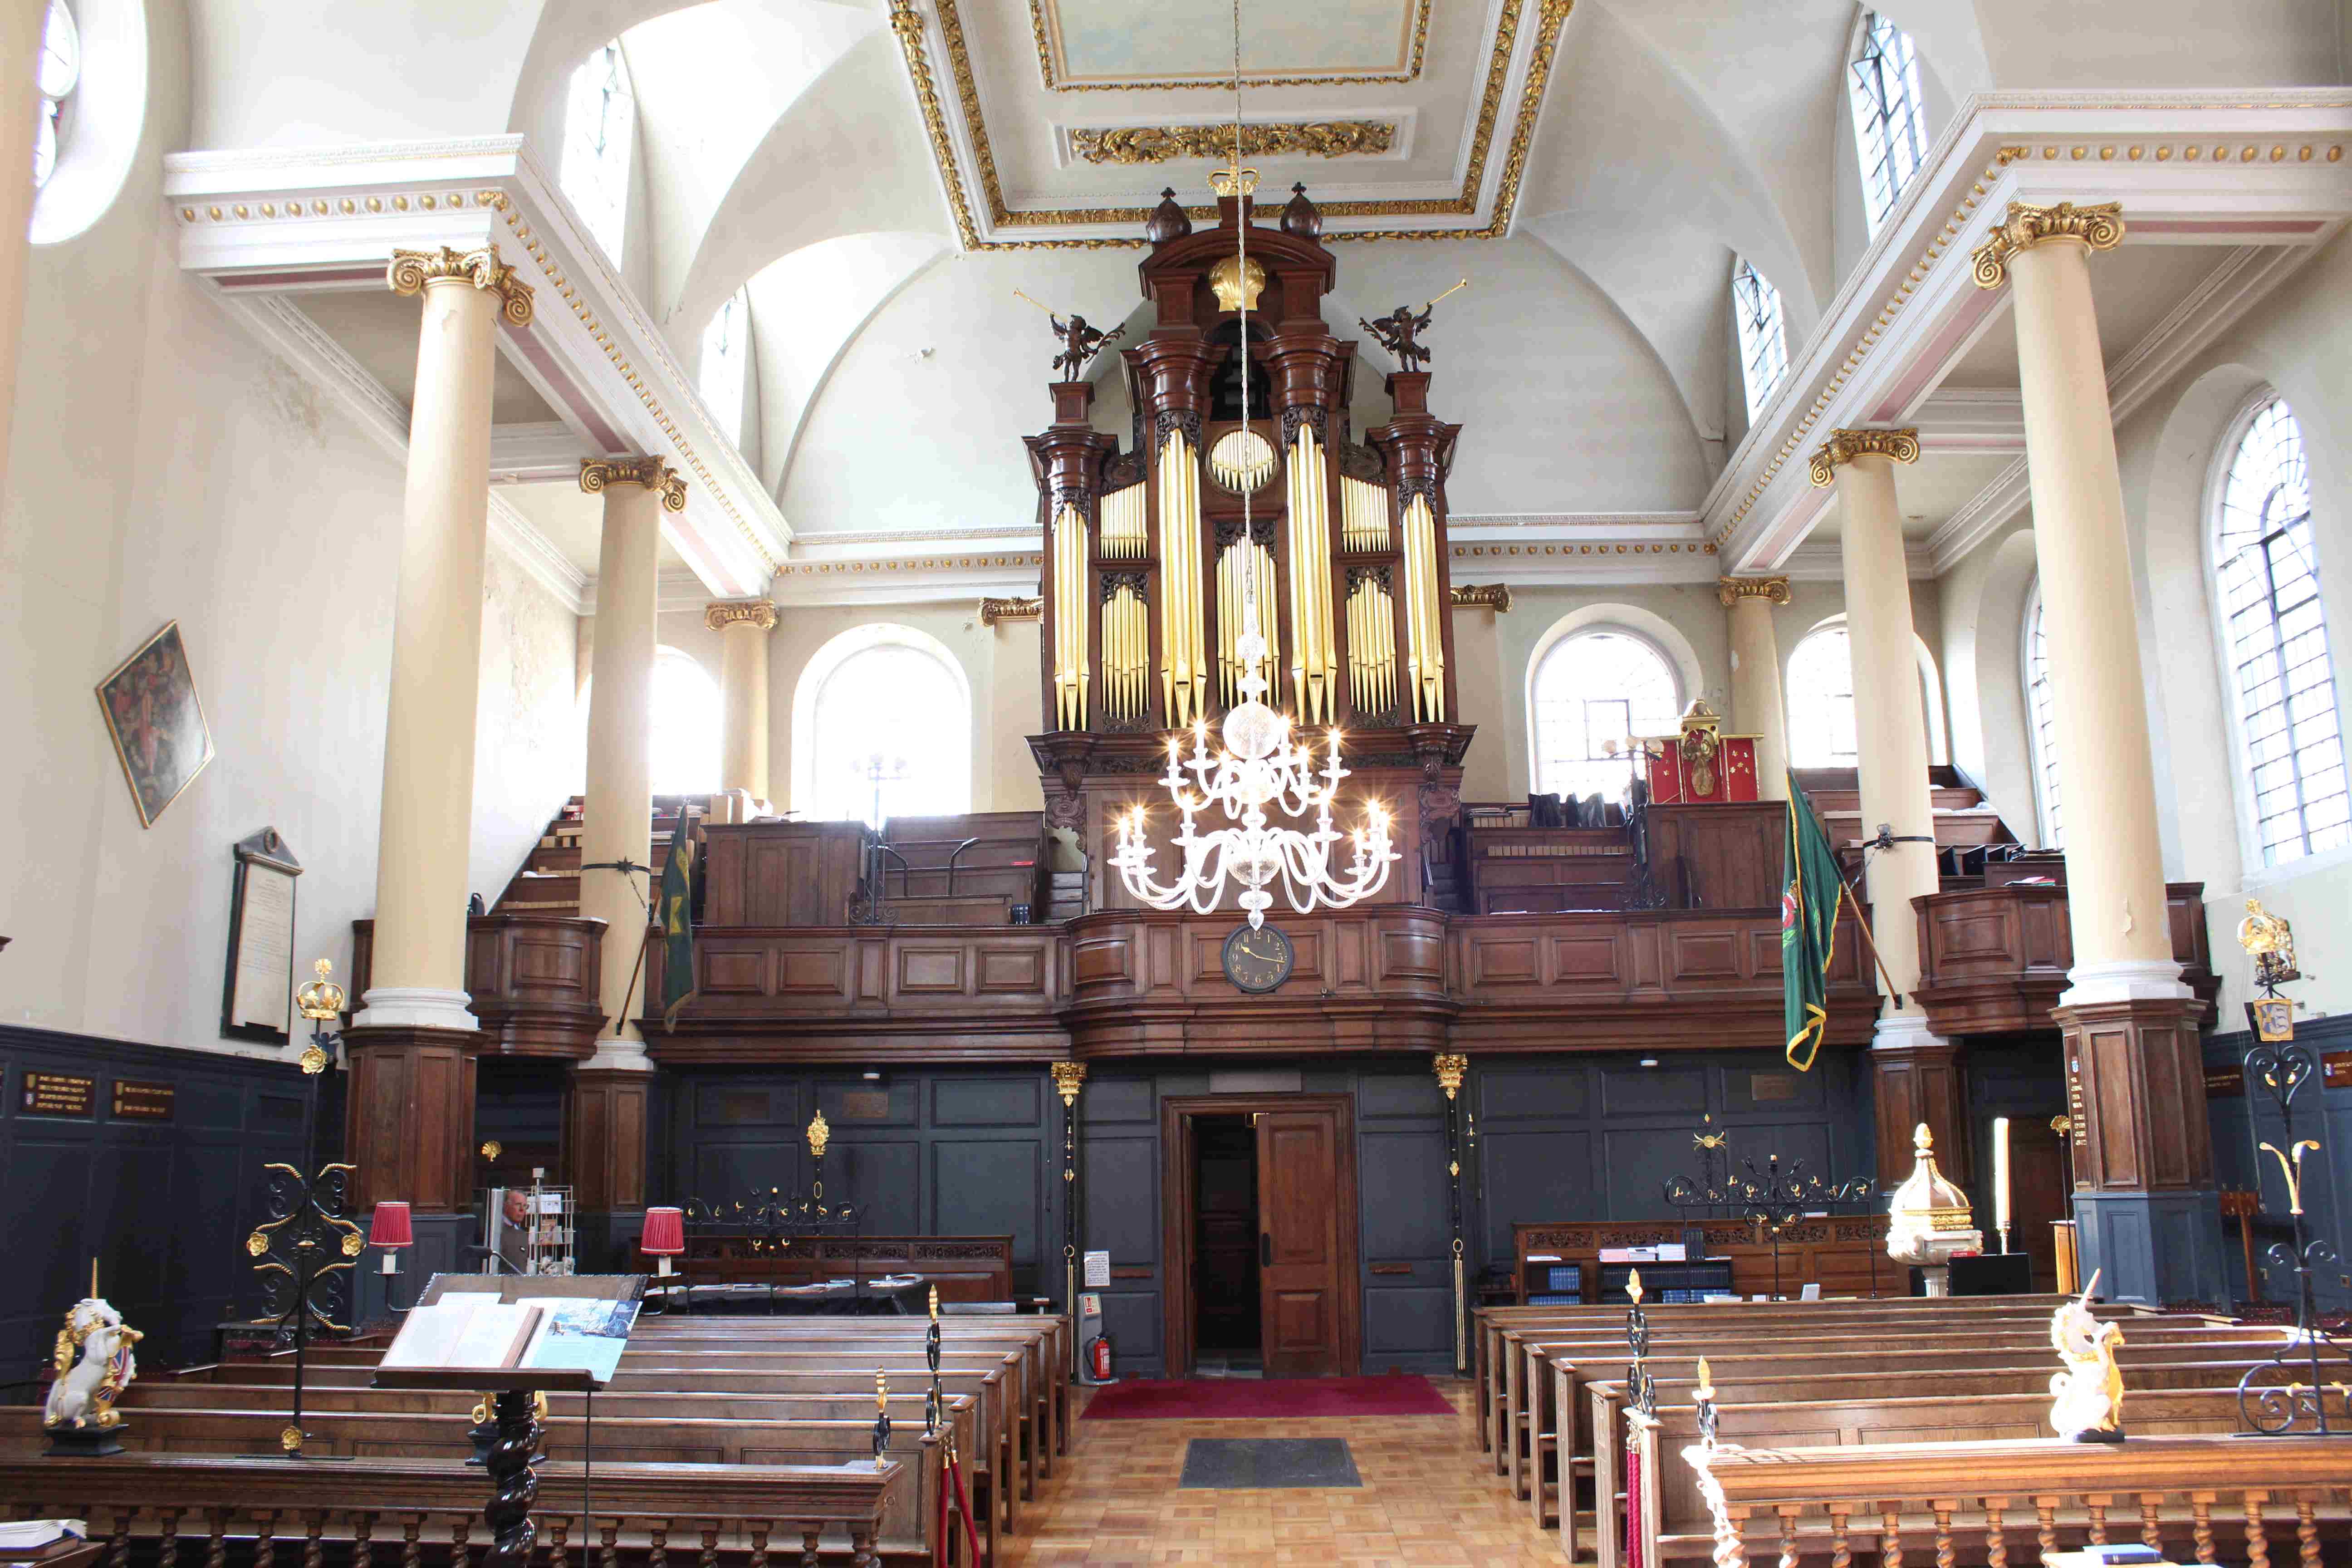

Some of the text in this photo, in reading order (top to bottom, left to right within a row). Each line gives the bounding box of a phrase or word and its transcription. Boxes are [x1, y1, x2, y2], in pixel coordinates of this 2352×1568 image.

[1244, 934, 1249, 943] 11
[1254, 931, 1261, 940] 12
[1267, 934, 1270, 943] 1
[1232, 954, 1238, 962] 9
[1235, 965, 1241, 973] 8
